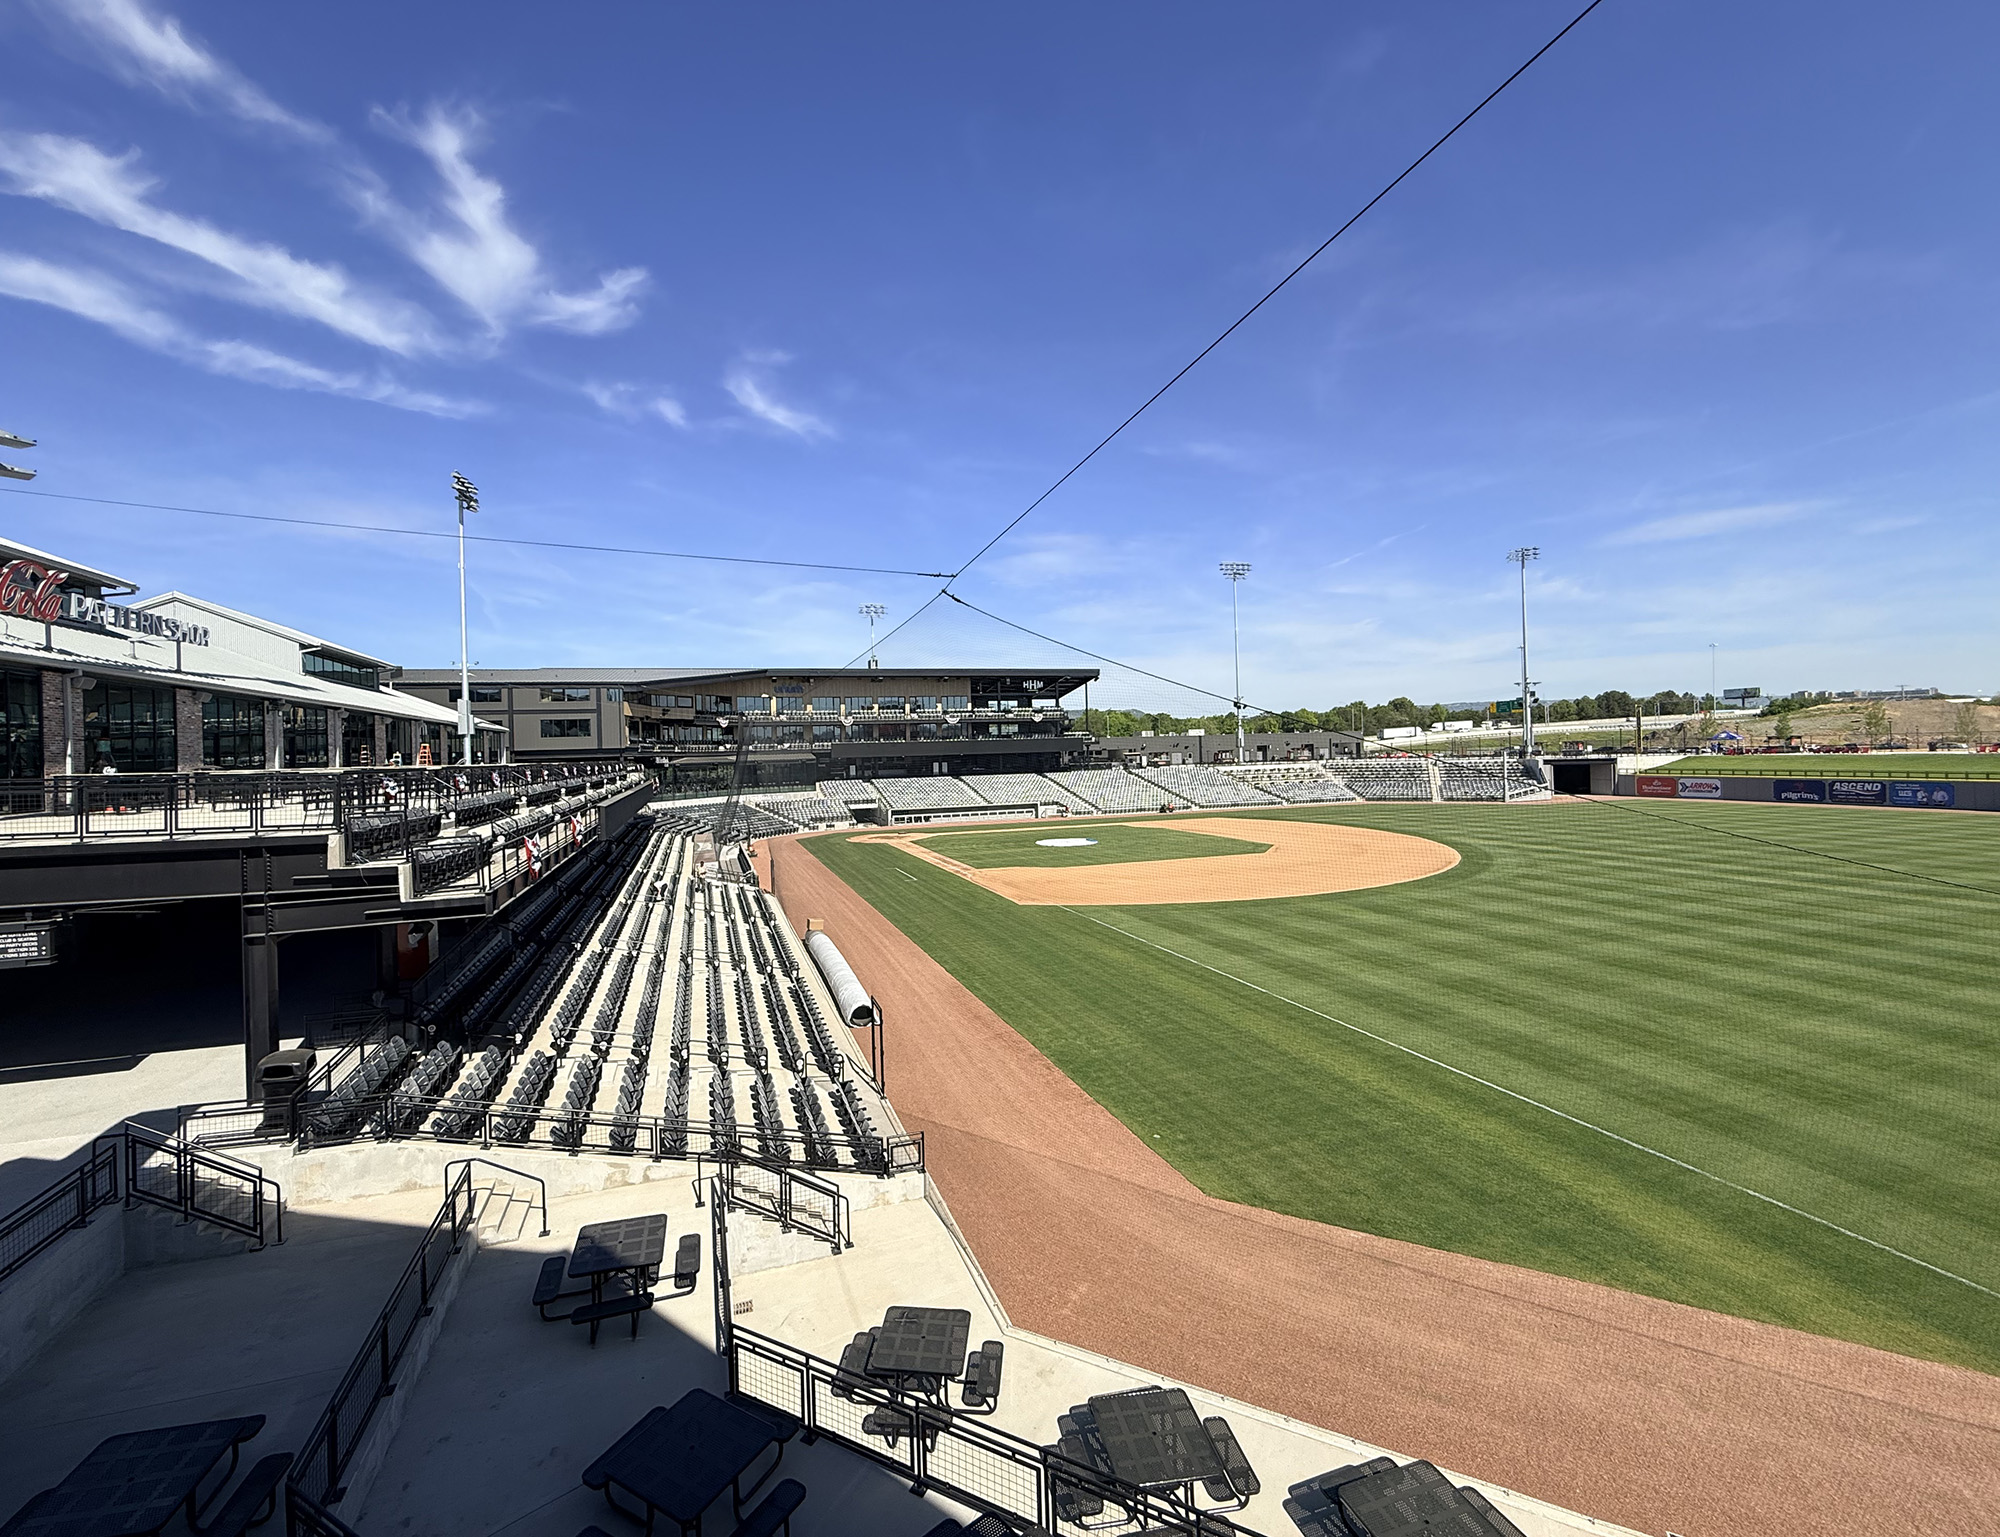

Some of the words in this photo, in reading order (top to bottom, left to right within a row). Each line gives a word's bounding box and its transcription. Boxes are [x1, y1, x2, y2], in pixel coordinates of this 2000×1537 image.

[69, 592, 164, 636] PATTERN
[166, 618, 210, 647] SHOP
[1832, 782, 1882, 791] ASCEND
[1781, 791, 1820, 800] Pilgrim's
